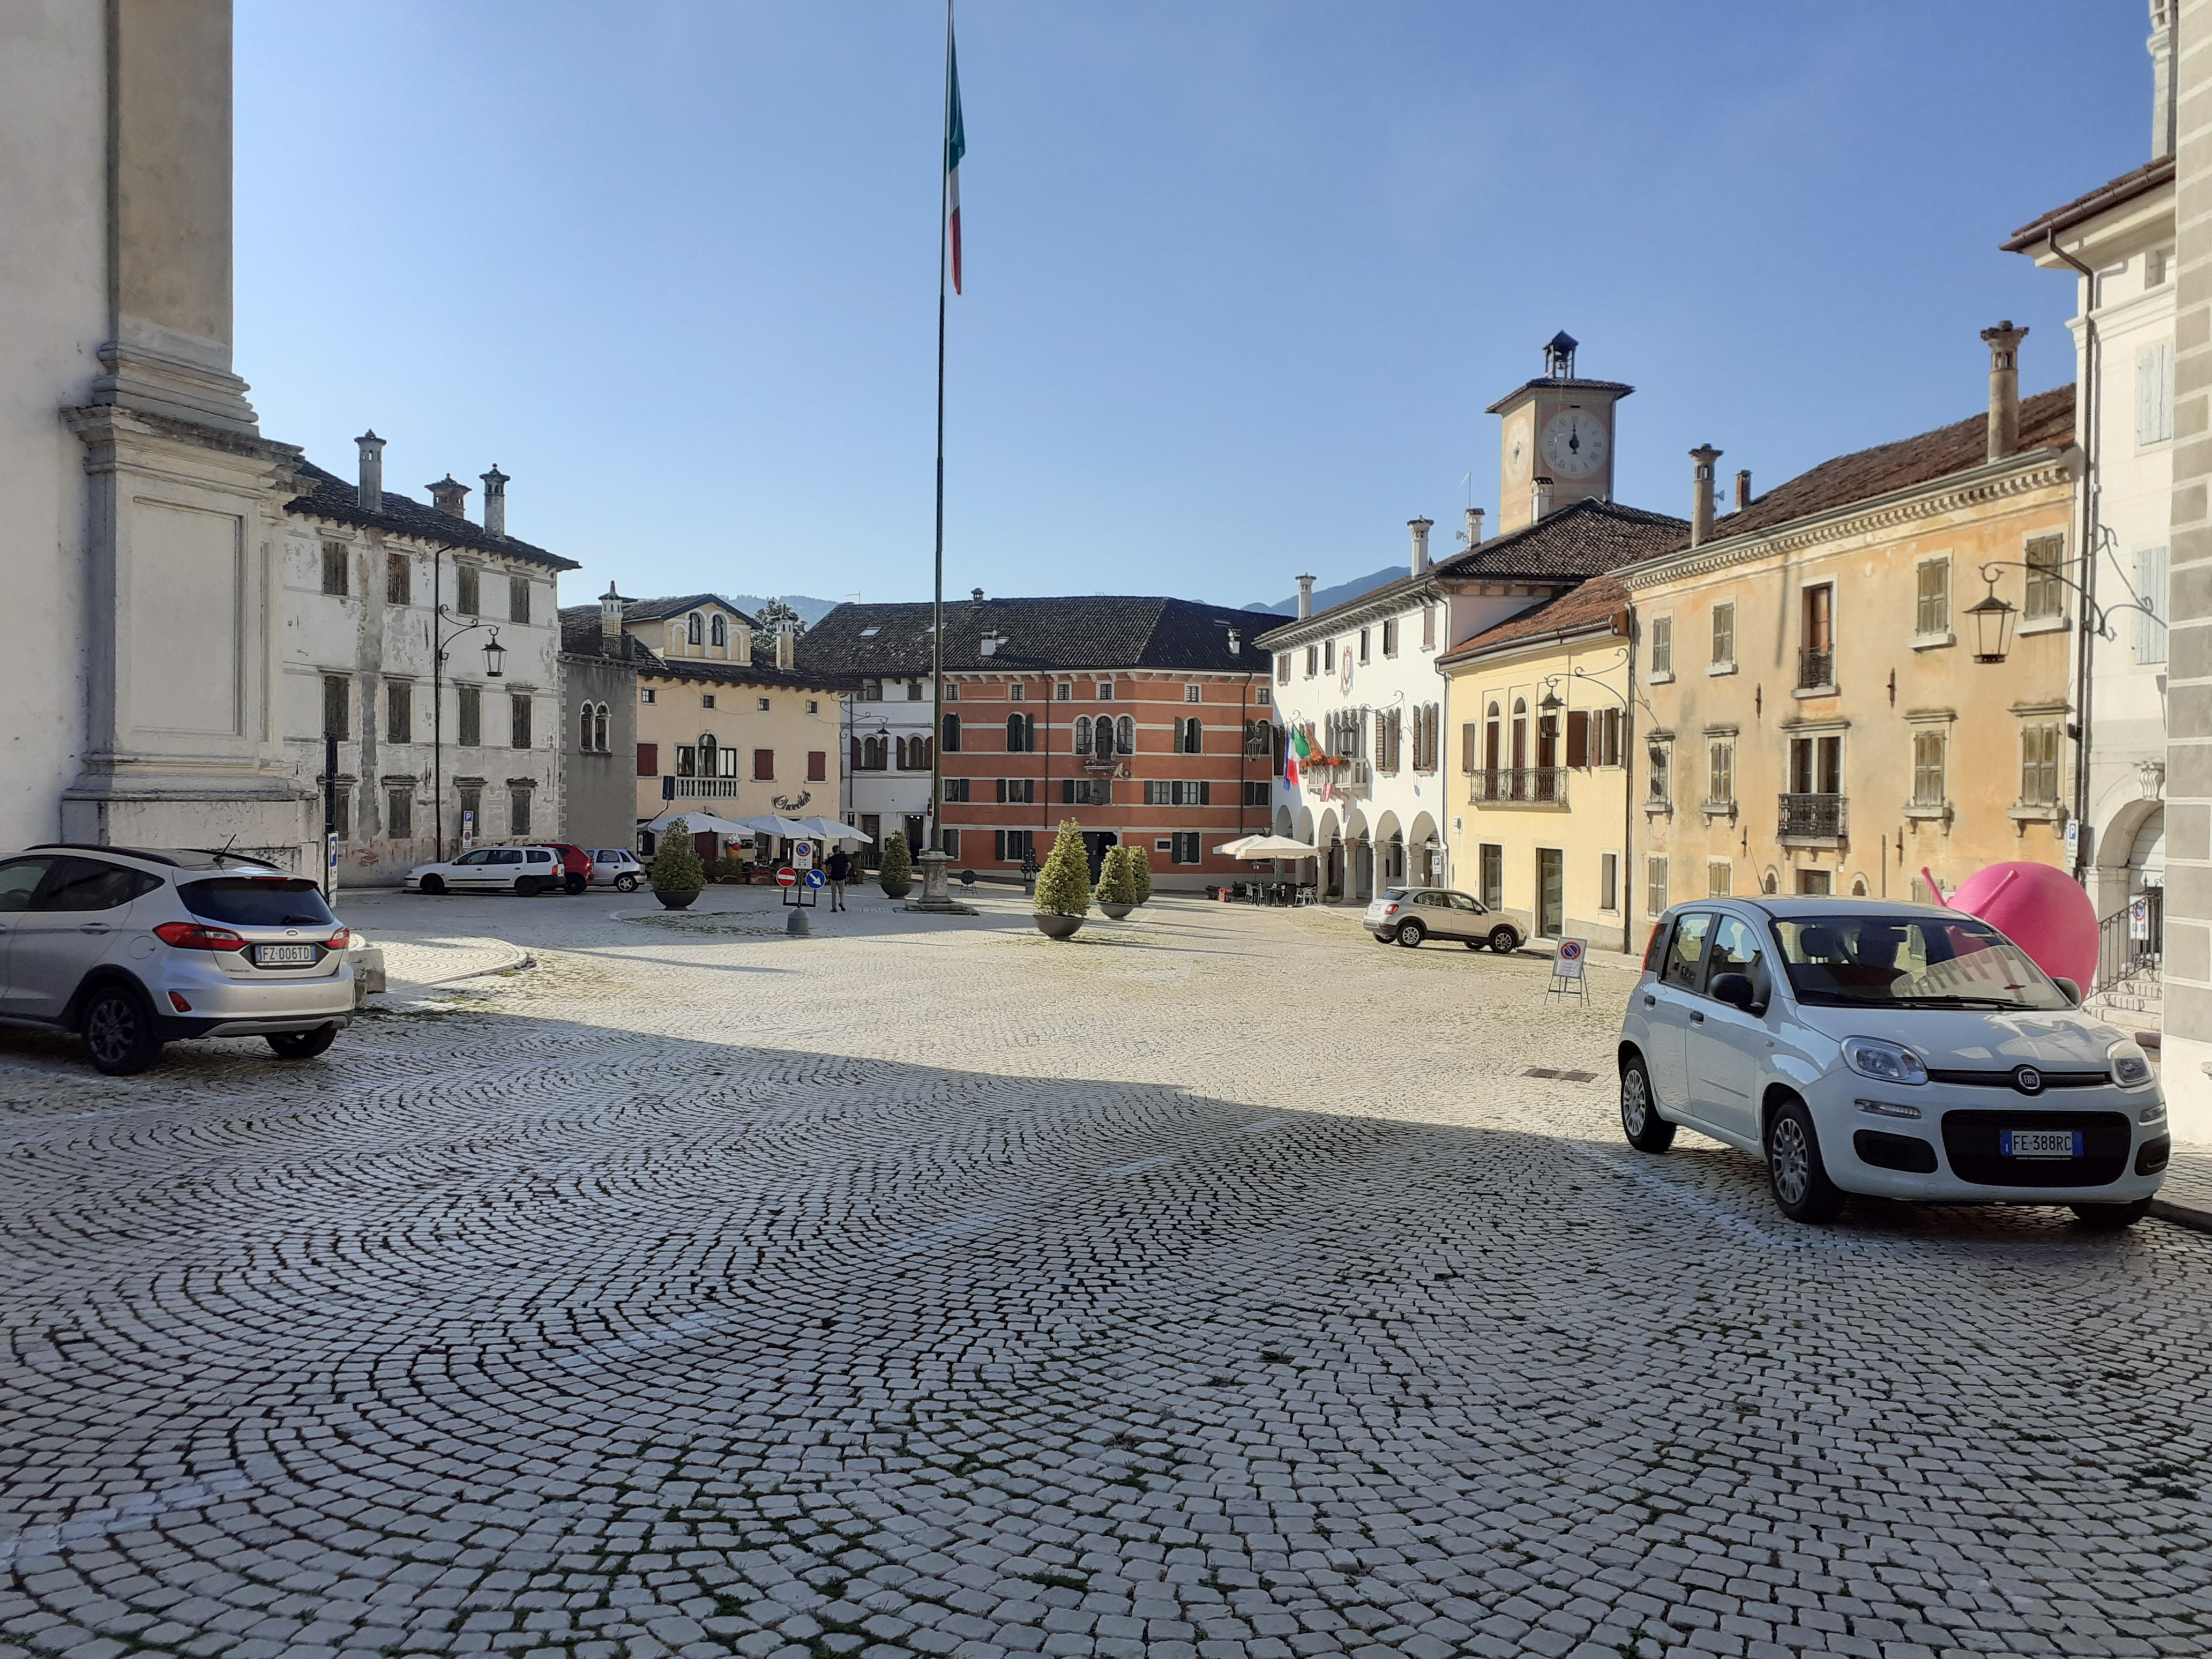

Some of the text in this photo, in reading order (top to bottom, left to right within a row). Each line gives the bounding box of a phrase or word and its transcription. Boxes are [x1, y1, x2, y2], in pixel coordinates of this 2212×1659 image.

[466, 812, 471, 821] P
[848, 812, 854, 823] T
[2070, 825, 2075, 838] P
[331, 840, 335, 863] P
[2023, 1075, 2036, 1085] FIAT
